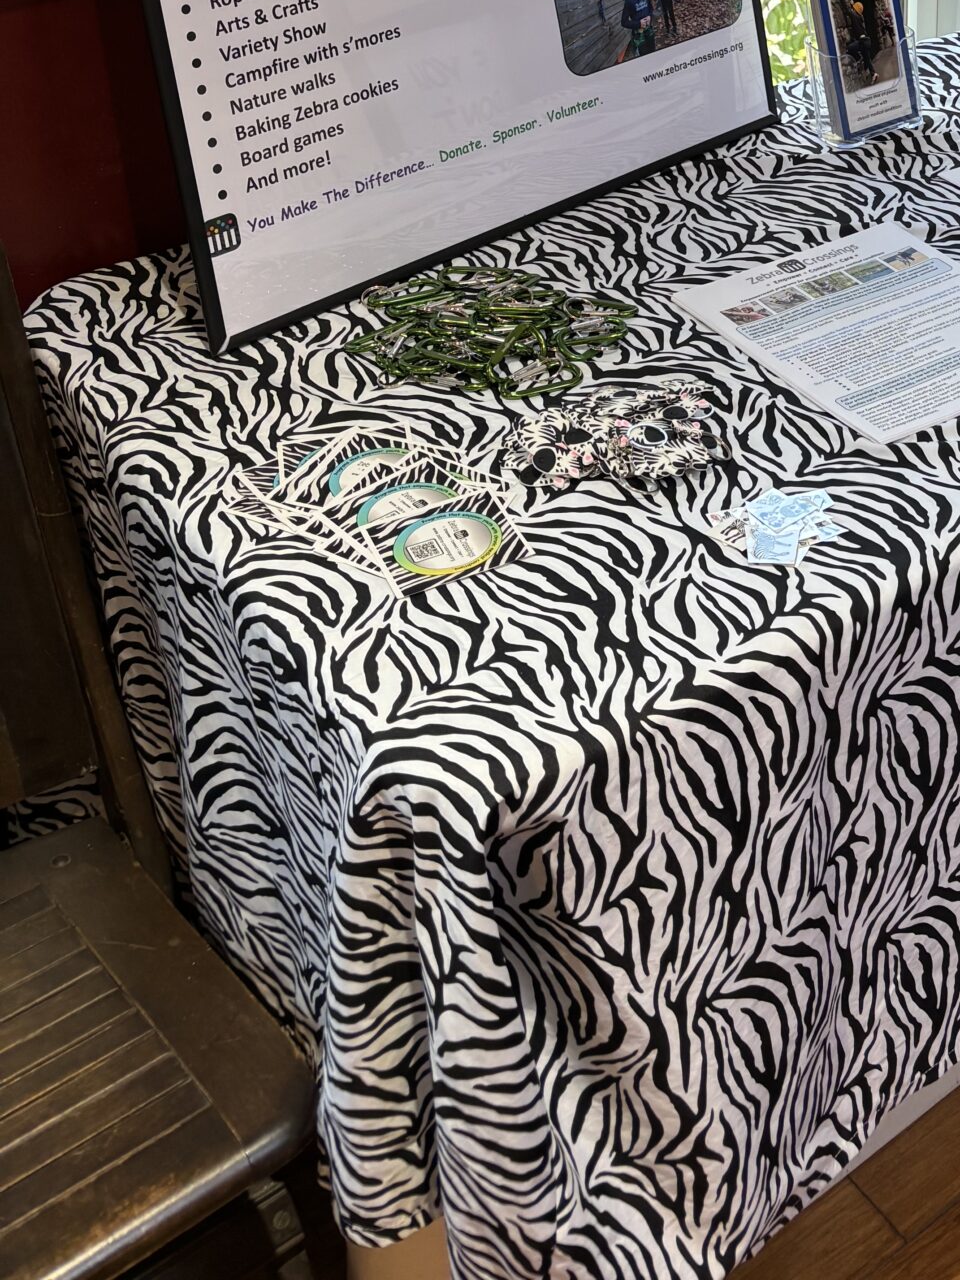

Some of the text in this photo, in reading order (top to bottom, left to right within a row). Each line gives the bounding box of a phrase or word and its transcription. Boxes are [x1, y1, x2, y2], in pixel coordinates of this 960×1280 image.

[215, 16, 251, 37] Arts
[254, 8, 269, 25] &
[218, 22, 327, 62] Variety Show
[225, 57, 300, 89] Campfire
[303, 42, 339, 65] with
[642, 42, 744, 84] www.zebra-crossings.org
[229, 72, 336, 116] Nature walks
[235, 79, 399, 142] Baking Zebra cookies
[240, 123, 345, 167] Board games
[246, 97, 604, 233] You Make The Difference... Donate. Sponsor. Volunteer.
[246, 149, 332, 194] And more!
[746, 243, 859, 285] Zebra Crossings
